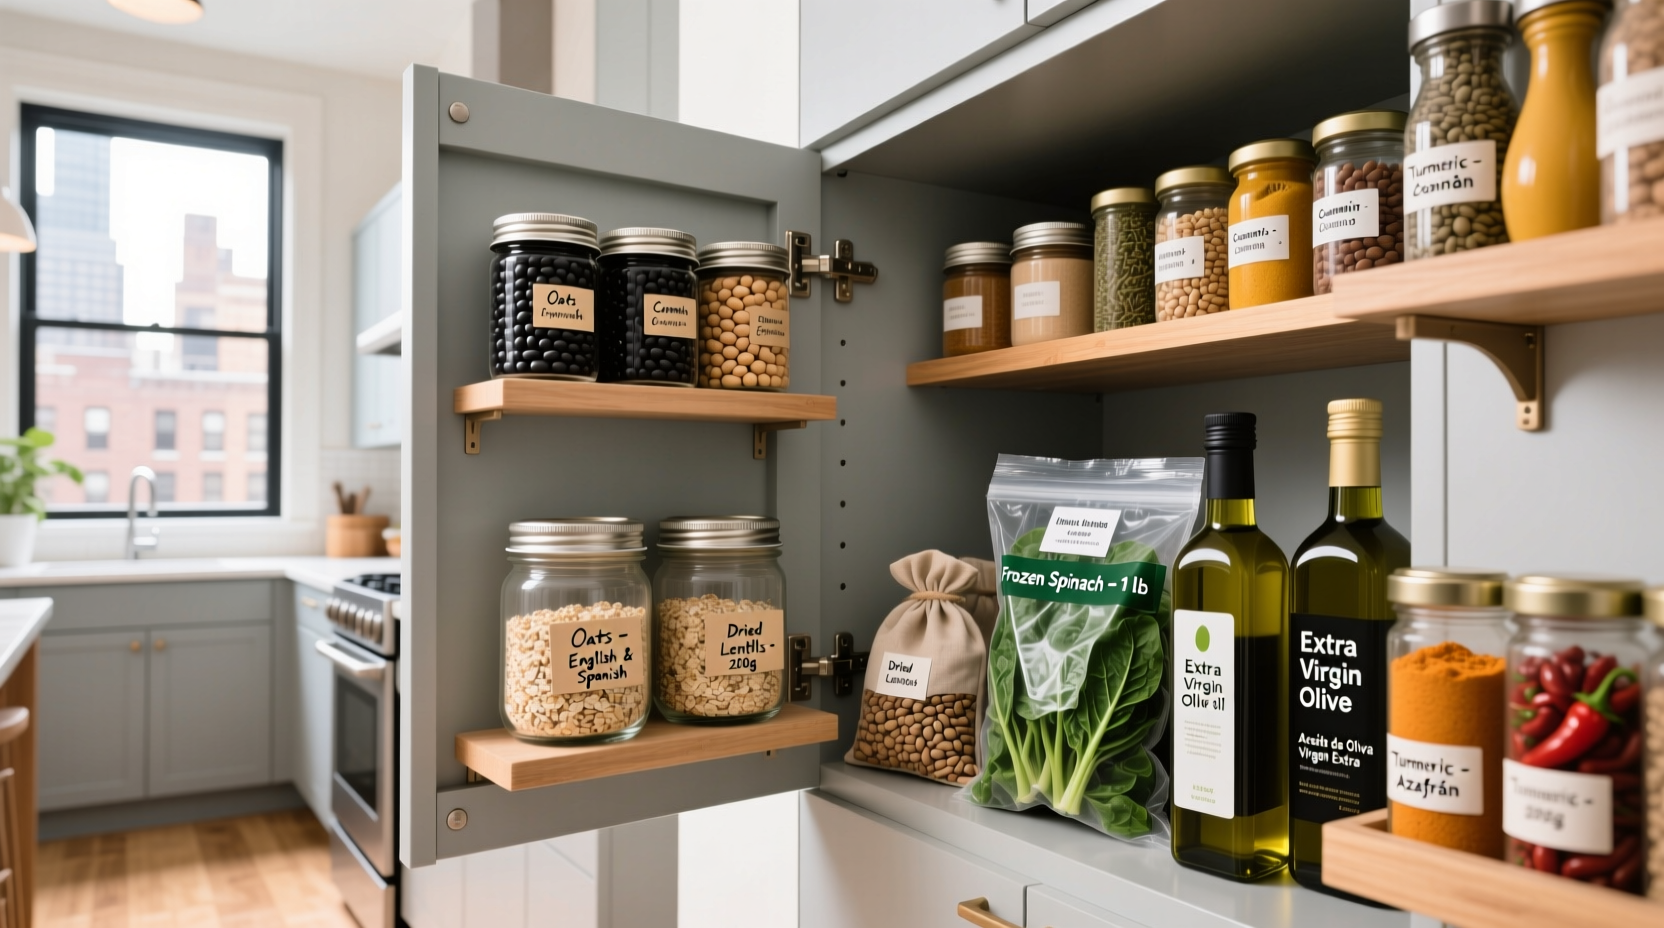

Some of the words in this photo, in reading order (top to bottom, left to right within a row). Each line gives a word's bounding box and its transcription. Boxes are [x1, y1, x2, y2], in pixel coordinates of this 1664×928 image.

[547, 290, 577, 306] Oats
[1001, 566, 1045, 587] Frozen
[1048, 571, 1104, 593] Spinach
[1121, 576, 1128, 592] 1
[1132, 576, 1149, 595] lb
[571, 627, 613, 648] Oats
[727, 621, 763, 638] Dried
[623, 647, 633, 661] &
[1300, 630, 1358, 657] Extra
[728, 657, 757, 672] 200g
[1185, 658, 1221, 676] Extra
[1299, 658, 1362, 689] Virgin
[577, 665, 628, 689] Spanish
[1299, 686, 1353, 713] Olive
[1332, 751, 1361, 768] Extra
[1396, 774, 1460, 799] Azafrán
